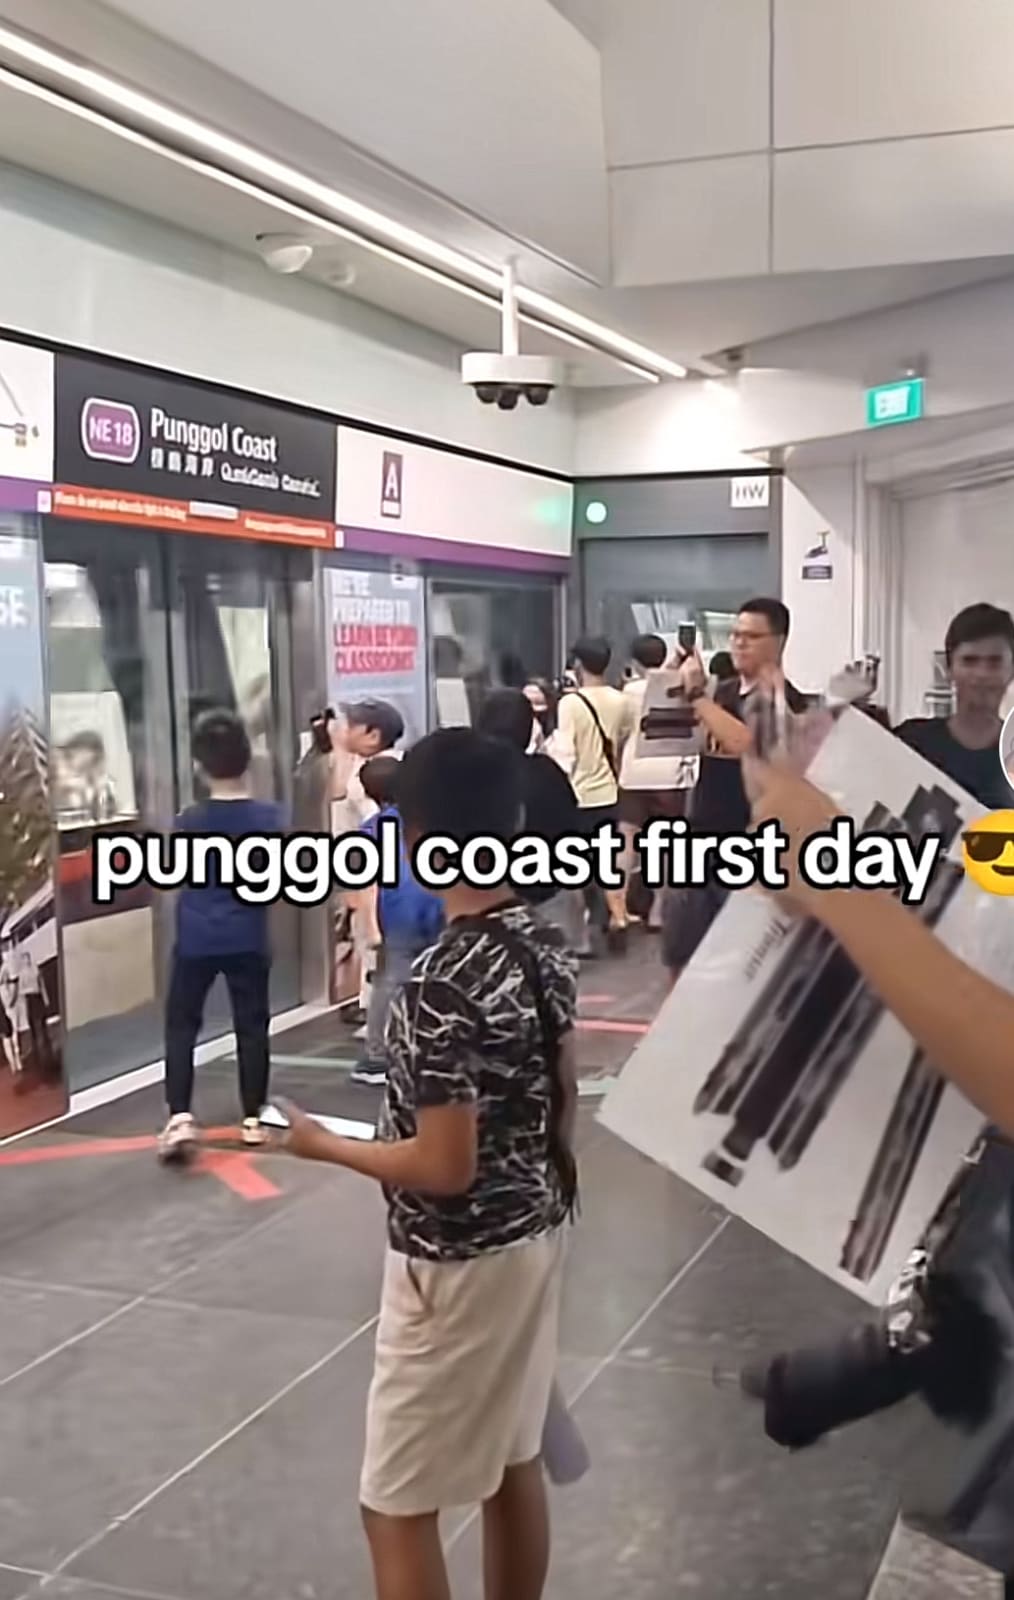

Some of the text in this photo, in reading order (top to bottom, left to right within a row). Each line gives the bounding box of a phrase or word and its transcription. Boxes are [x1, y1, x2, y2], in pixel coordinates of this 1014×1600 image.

[150, 407, 228, 455] Punggol
[231, 426, 277, 463] Coast
[384, 461, 399, 499] A
[735, 483, 765, 499] HW
